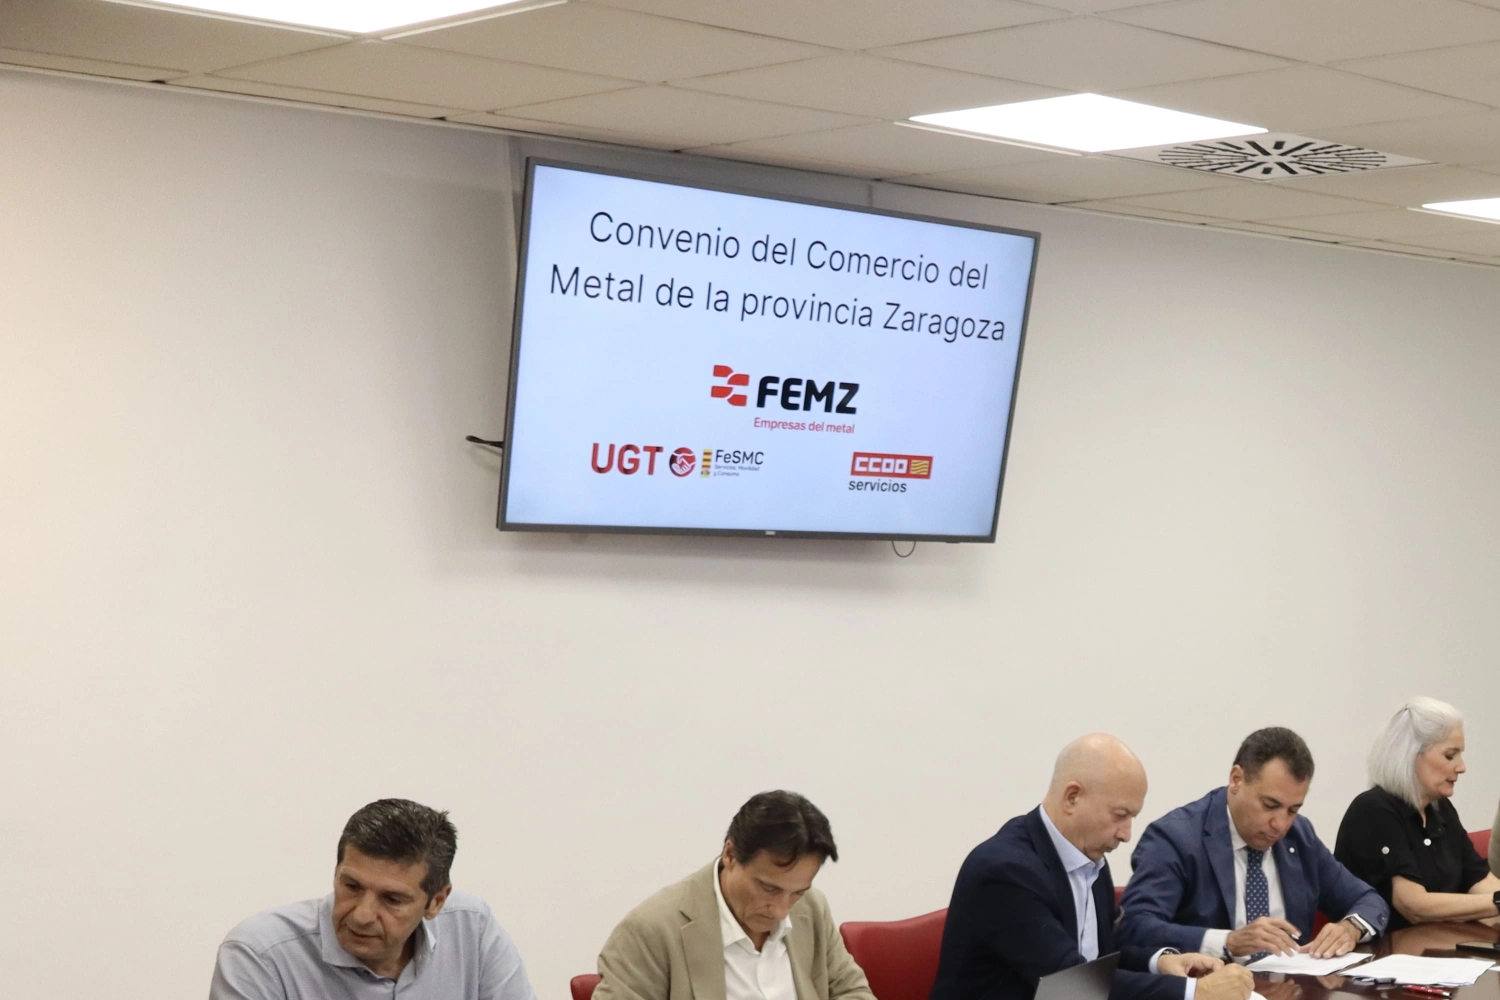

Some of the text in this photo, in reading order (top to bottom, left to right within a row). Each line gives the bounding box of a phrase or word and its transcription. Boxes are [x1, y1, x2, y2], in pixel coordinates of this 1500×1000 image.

[589, 211, 989, 290] Convenio del Comercio del
[550, 263, 1006, 344] Metal de la provincia Zaragoza
[756, 375, 860, 415] FEMZ
[753, 416, 856, 434] Empresas del metal
[591, 442, 664, 476] UGT
[714, 449, 765, 465] FeSMC
[854, 456, 909, 474] CCOO
[848, 478, 908, 493] servicios
